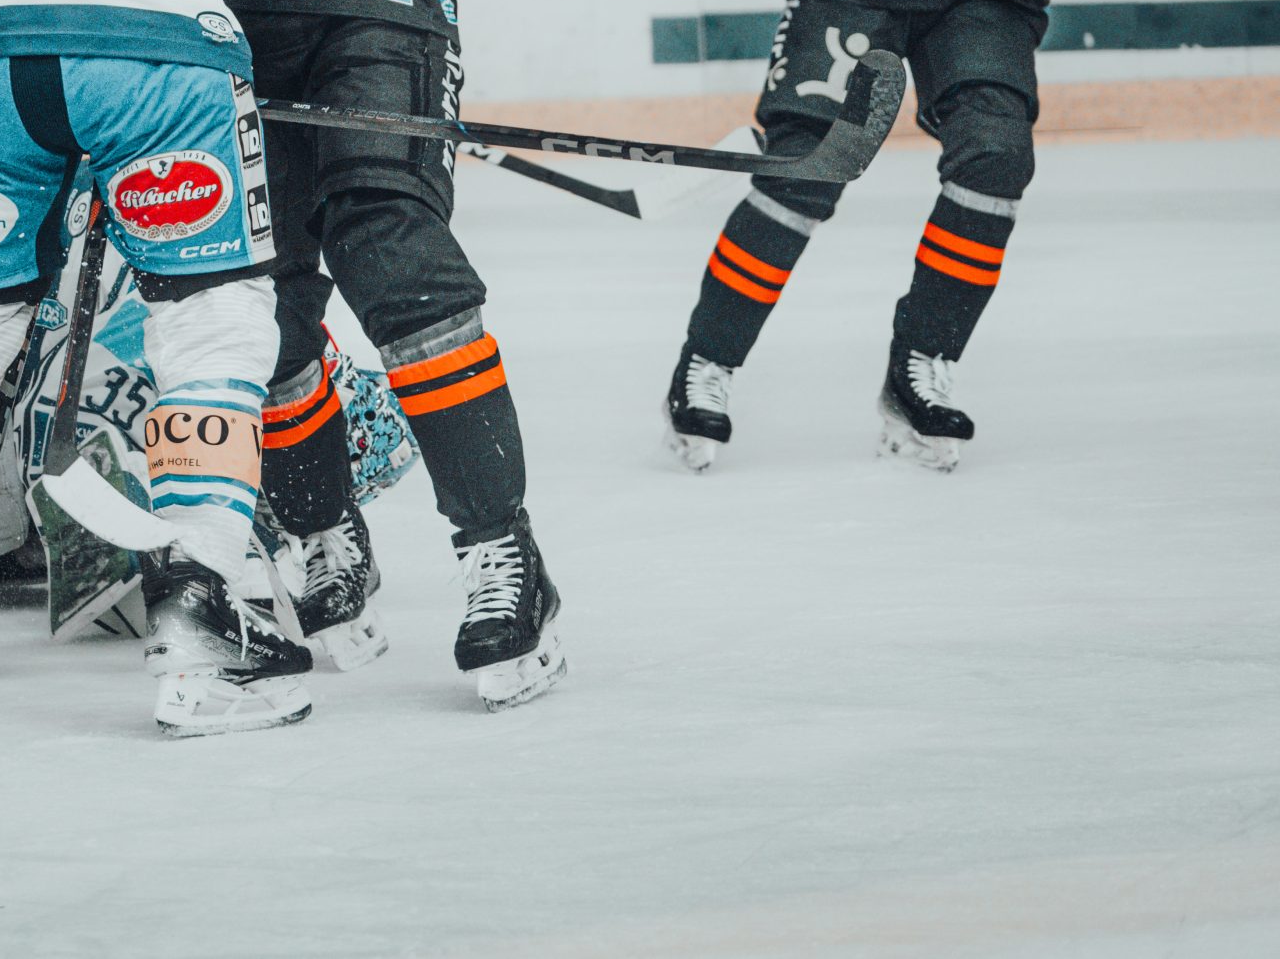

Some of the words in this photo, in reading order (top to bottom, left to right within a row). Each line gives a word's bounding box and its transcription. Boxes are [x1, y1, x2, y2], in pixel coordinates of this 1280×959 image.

[179, 238, 242, 259] CCM
[85, 365, 159, 431] 35
[167, 457, 202, 468] HOTEL
